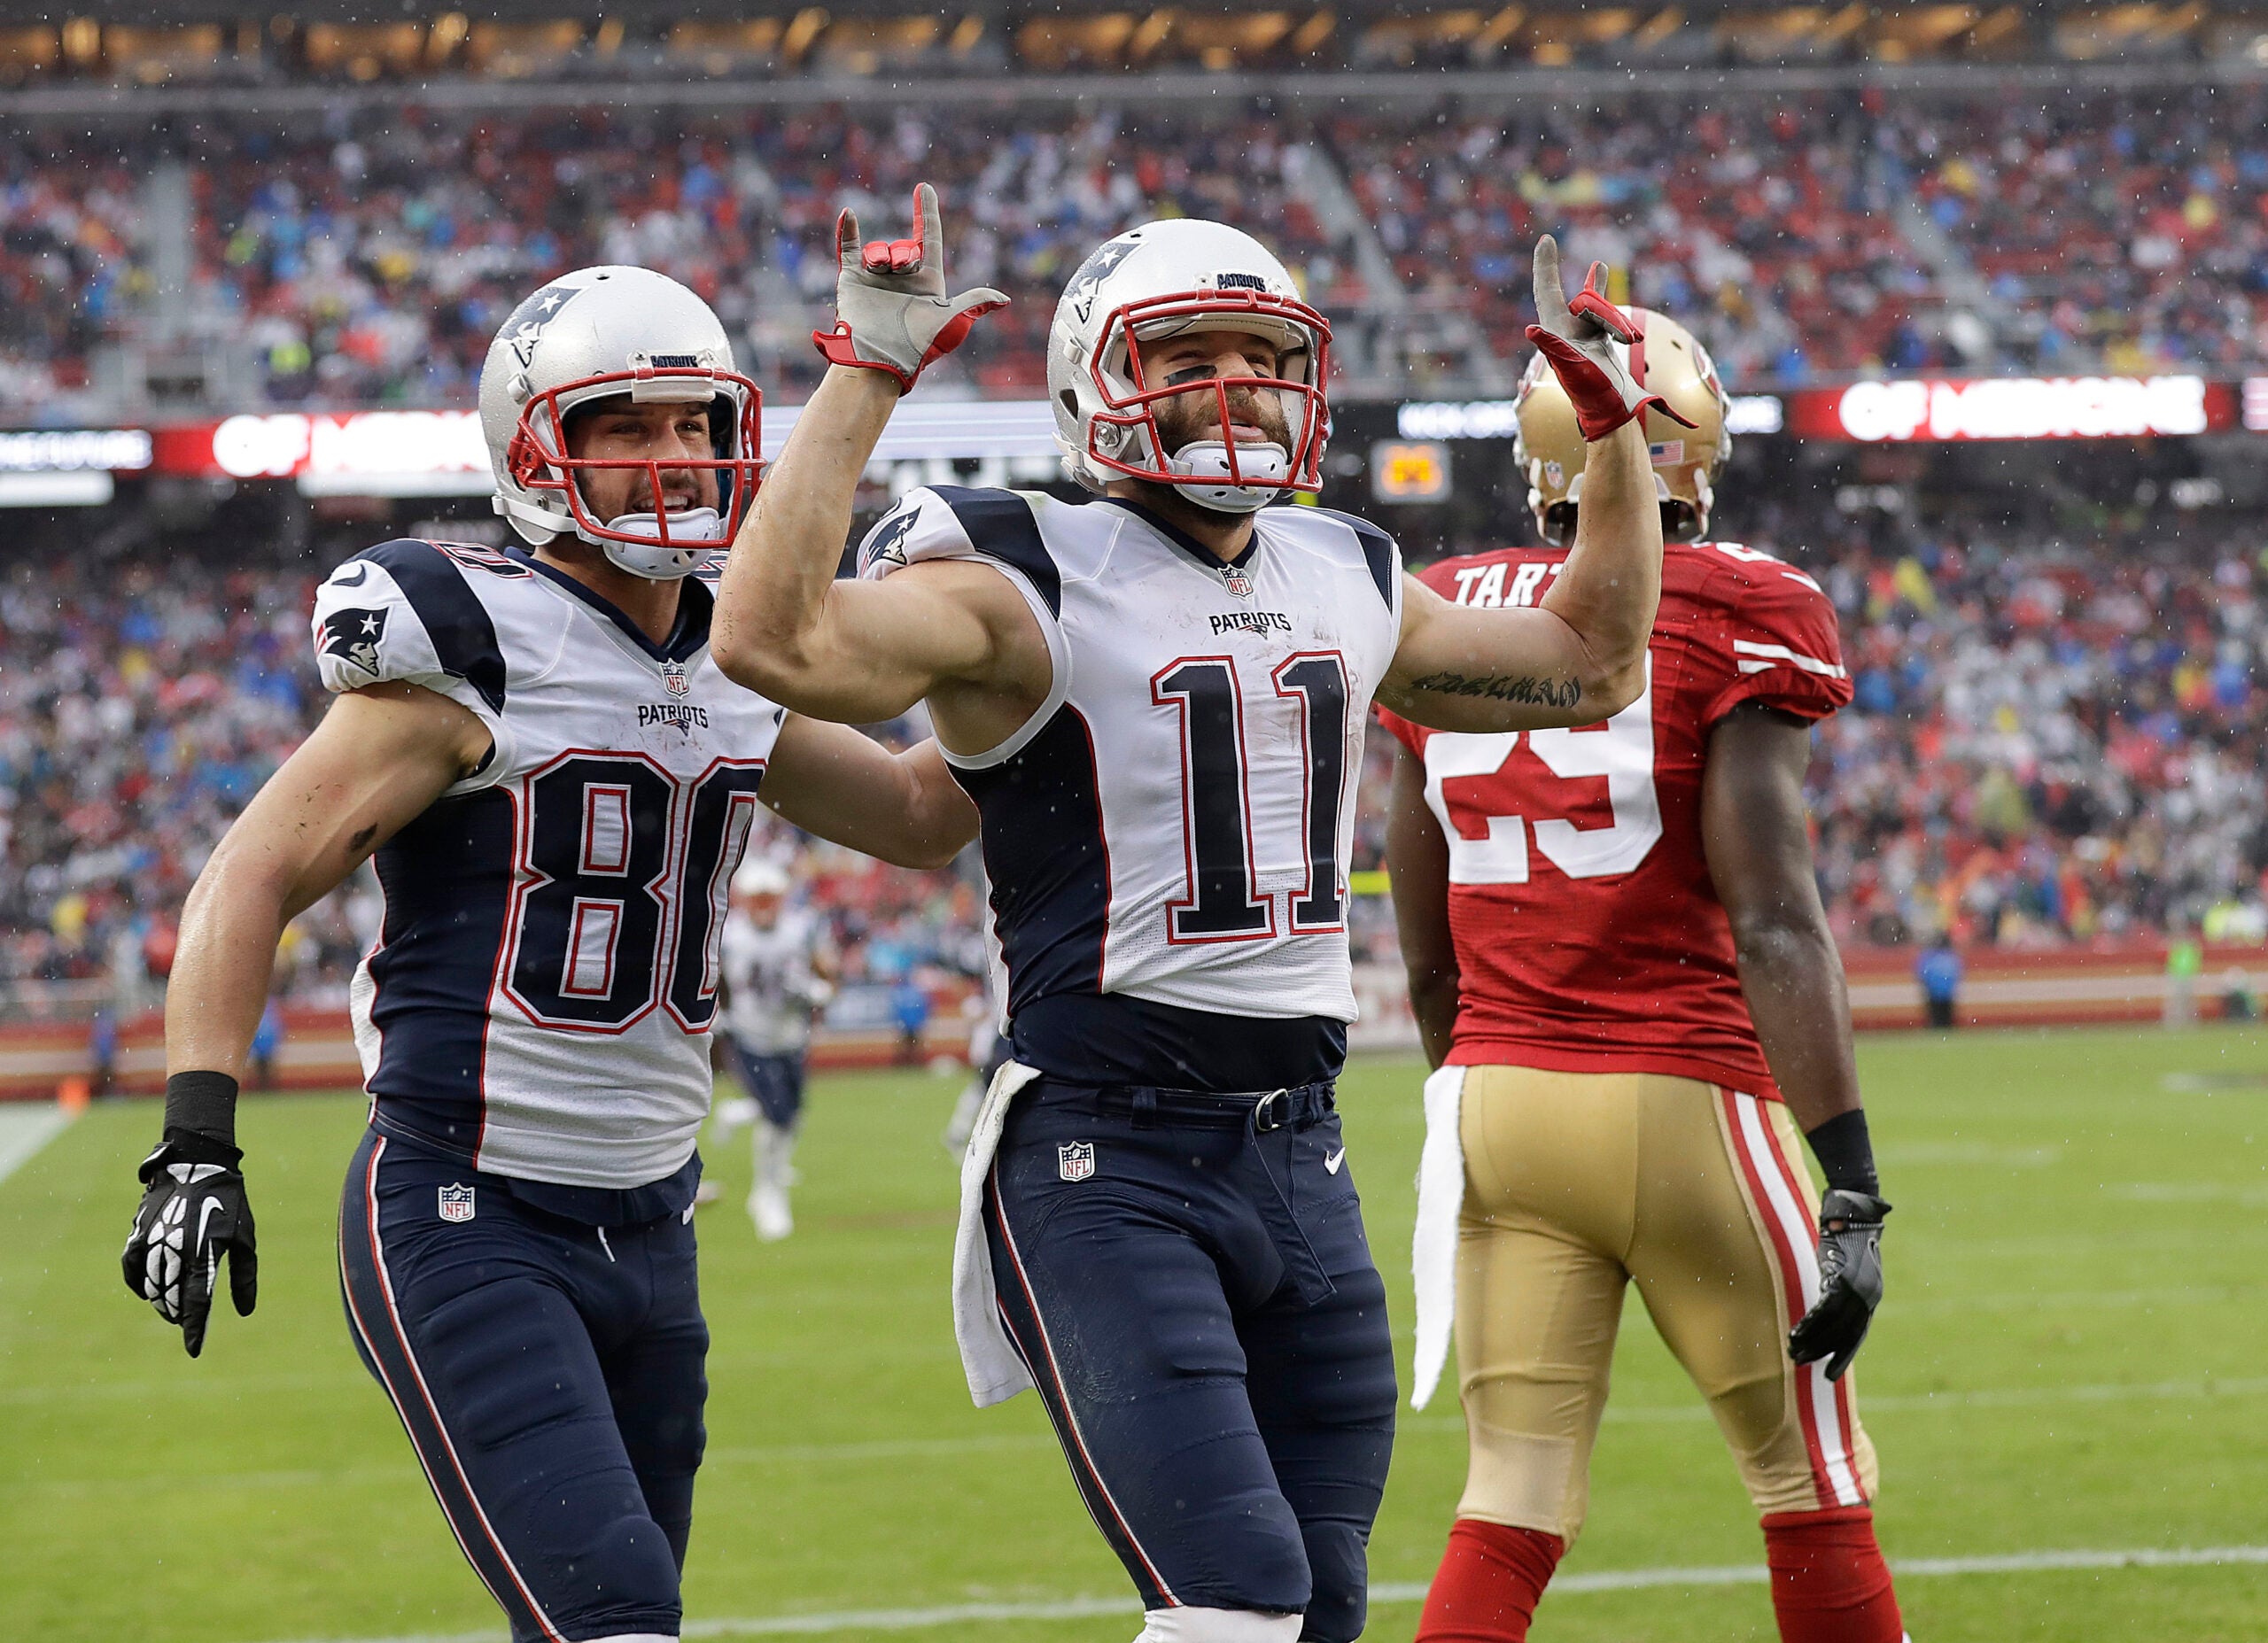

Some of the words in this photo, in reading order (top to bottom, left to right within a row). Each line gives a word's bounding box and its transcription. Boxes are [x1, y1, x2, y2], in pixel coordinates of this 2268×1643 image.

[1216, 273, 1266, 292] PATRIOTS
[1208, 612, 1292, 636] PATRIOTS
[637, 704, 709, 729] PATRIOTS
[1150, 650, 1351, 945] 11
[501, 748, 767, 1035] 80
[1065, 1159, 1090, 1177] NFL
[445, 1203, 470, 1218] NFL
